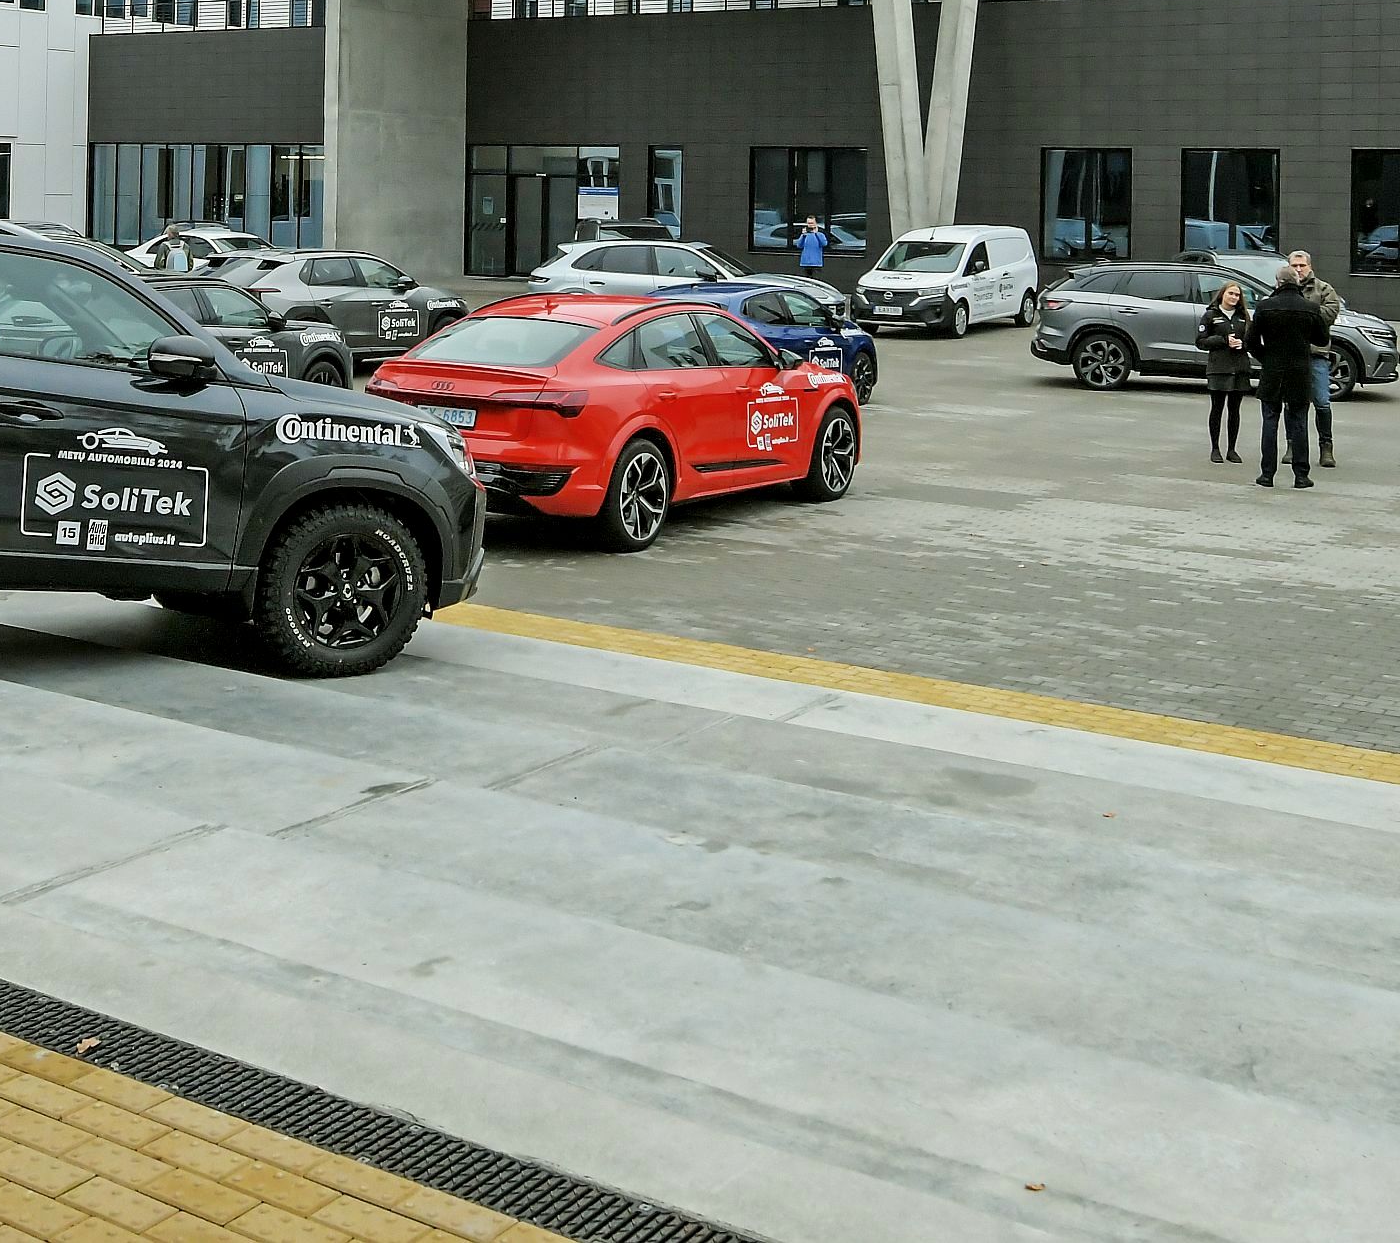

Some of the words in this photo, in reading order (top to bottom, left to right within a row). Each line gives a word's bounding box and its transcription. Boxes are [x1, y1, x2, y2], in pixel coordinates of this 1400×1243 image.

[391, 318, 416, 328] SoliTek
[251, 361, 284, 374] SoliTek
[763, 412, 794, 429] SoliTek
[275, 413, 402, 447] Continental
[58, 450, 85, 462] METŲ
[87, 452, 156, 467] AUTOMOBILIS
[157, 459, 183, 469] 2024
[81, 484, 193, 516] SoliTek
[61, 527, 76, 539] 15
[88, 521, 107, 534] Auto
[89, 533, 105, 546] Bild
[114, 531, 176, 546] autoplius.lt
